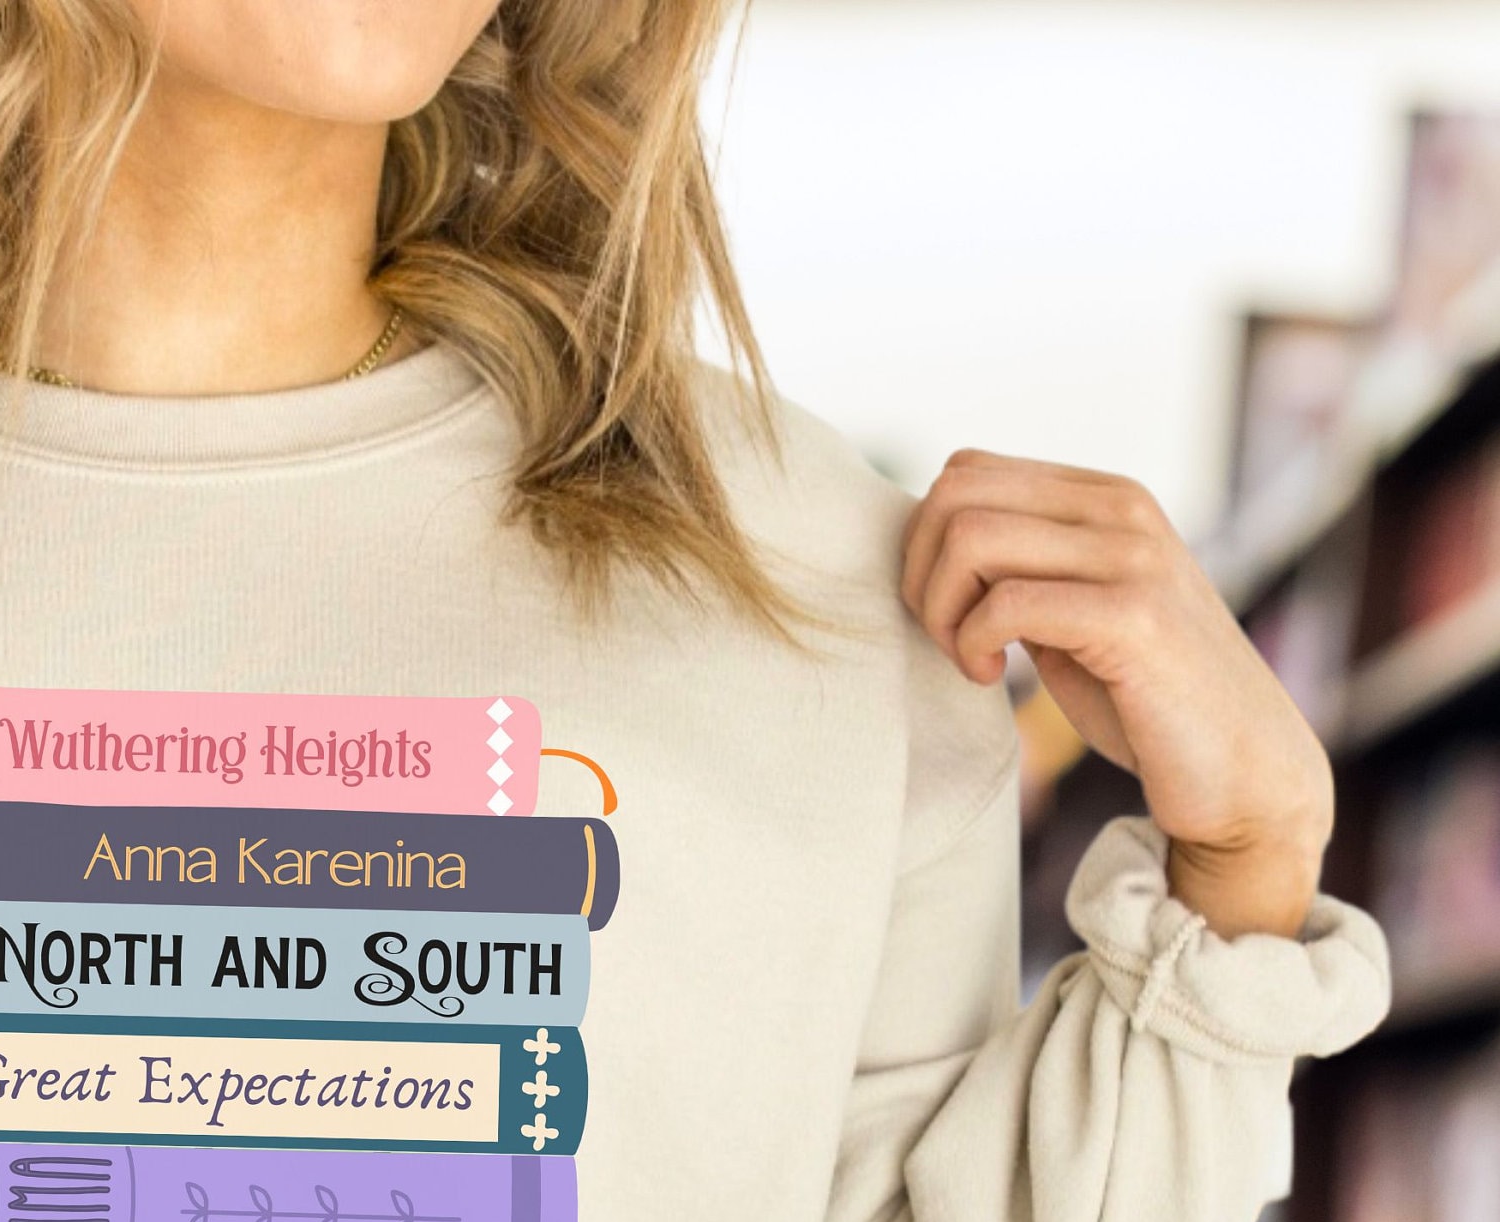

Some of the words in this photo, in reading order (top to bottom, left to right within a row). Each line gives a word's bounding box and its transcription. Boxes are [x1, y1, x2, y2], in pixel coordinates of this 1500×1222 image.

[259, 724, 432, 788] Heights
[83, 833, 217, 883] Anna
[238, 837, 467, 889] Karenina
[211, 936, 328, 991] AND
[354, 931, 563, 1018] SOUTH
[138, 1055, 474, 1126] Expectations
